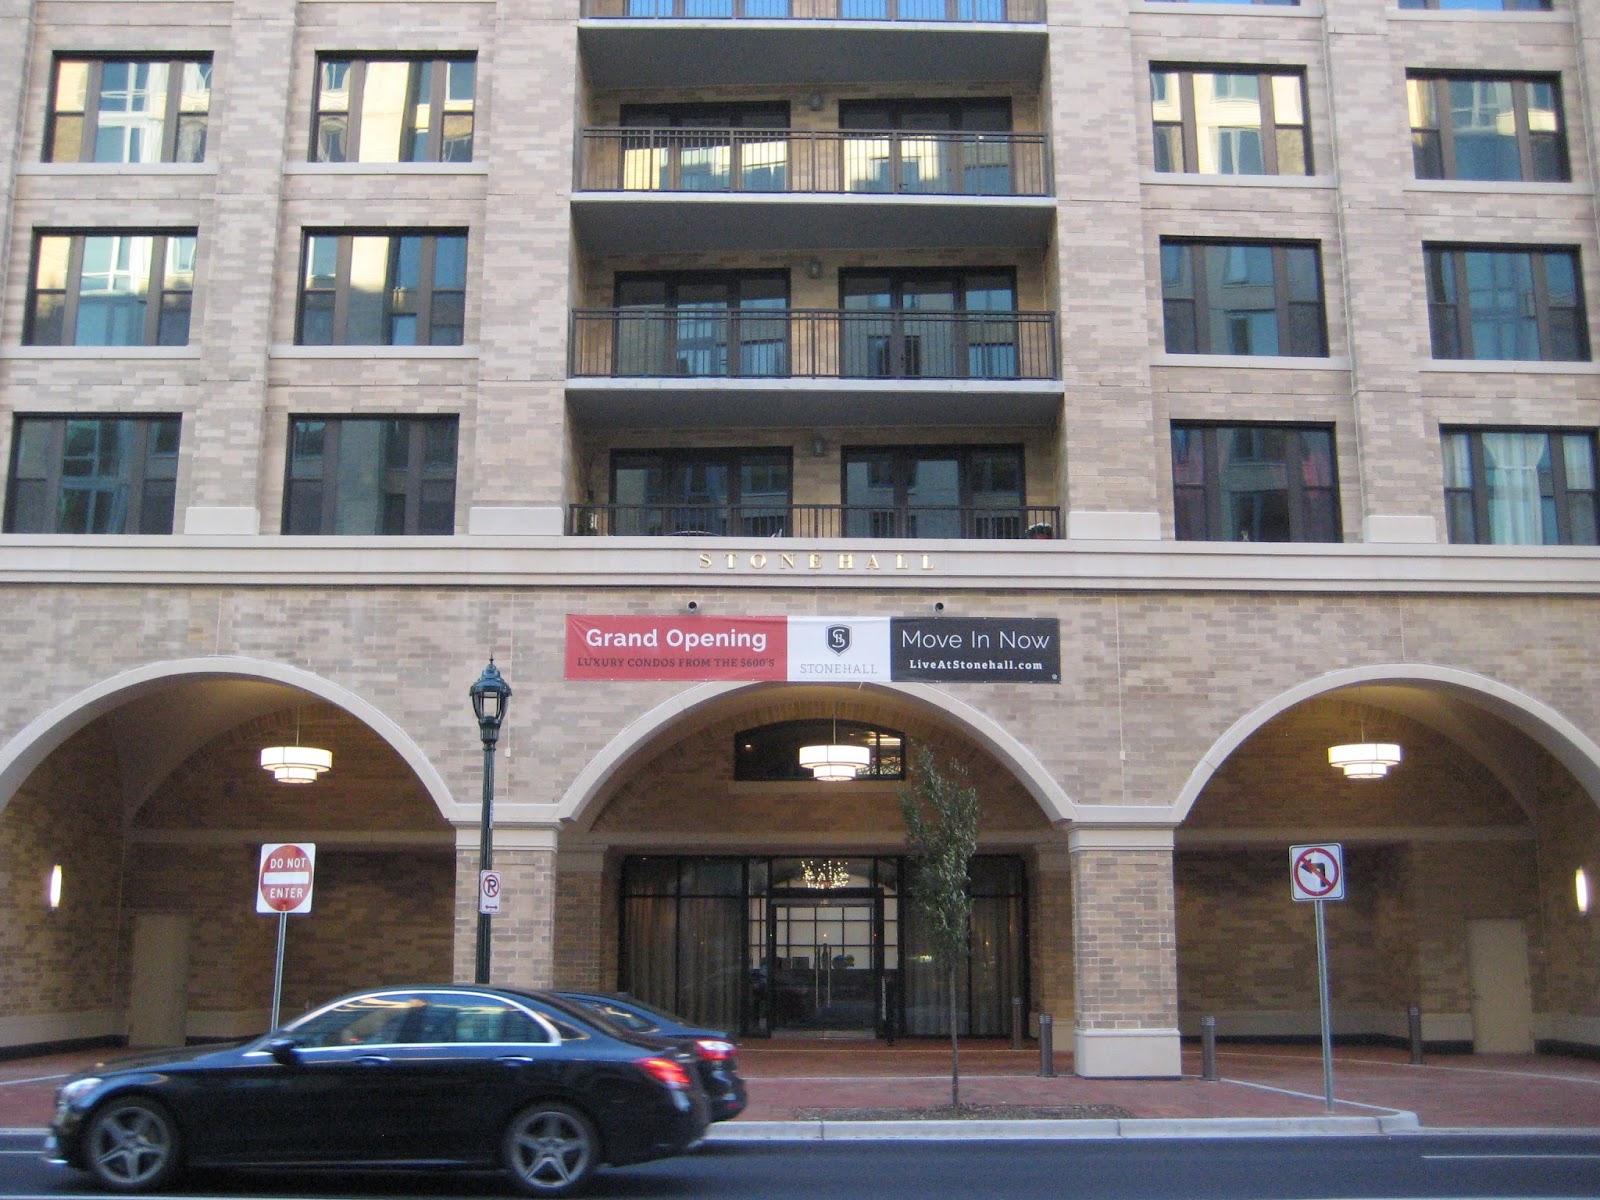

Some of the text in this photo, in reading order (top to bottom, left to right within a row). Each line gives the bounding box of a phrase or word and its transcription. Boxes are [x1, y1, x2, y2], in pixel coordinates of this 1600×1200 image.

[700, 553, 935, 570] STONEHALL
[586, 628, 767, 652] Grand Opening
[902, 630, 1050, 650] Move In Now
[577, 657, 775, 668] LUXURY CONDOS FROM THE $600'S
[909, 659, 1043, 671] LiveAtStonehall.com
[799, 663, 878, 675] STONEHALL
[270, 857, 307, 869] DO NOT
[270, 887, 304, 899] ENTER
